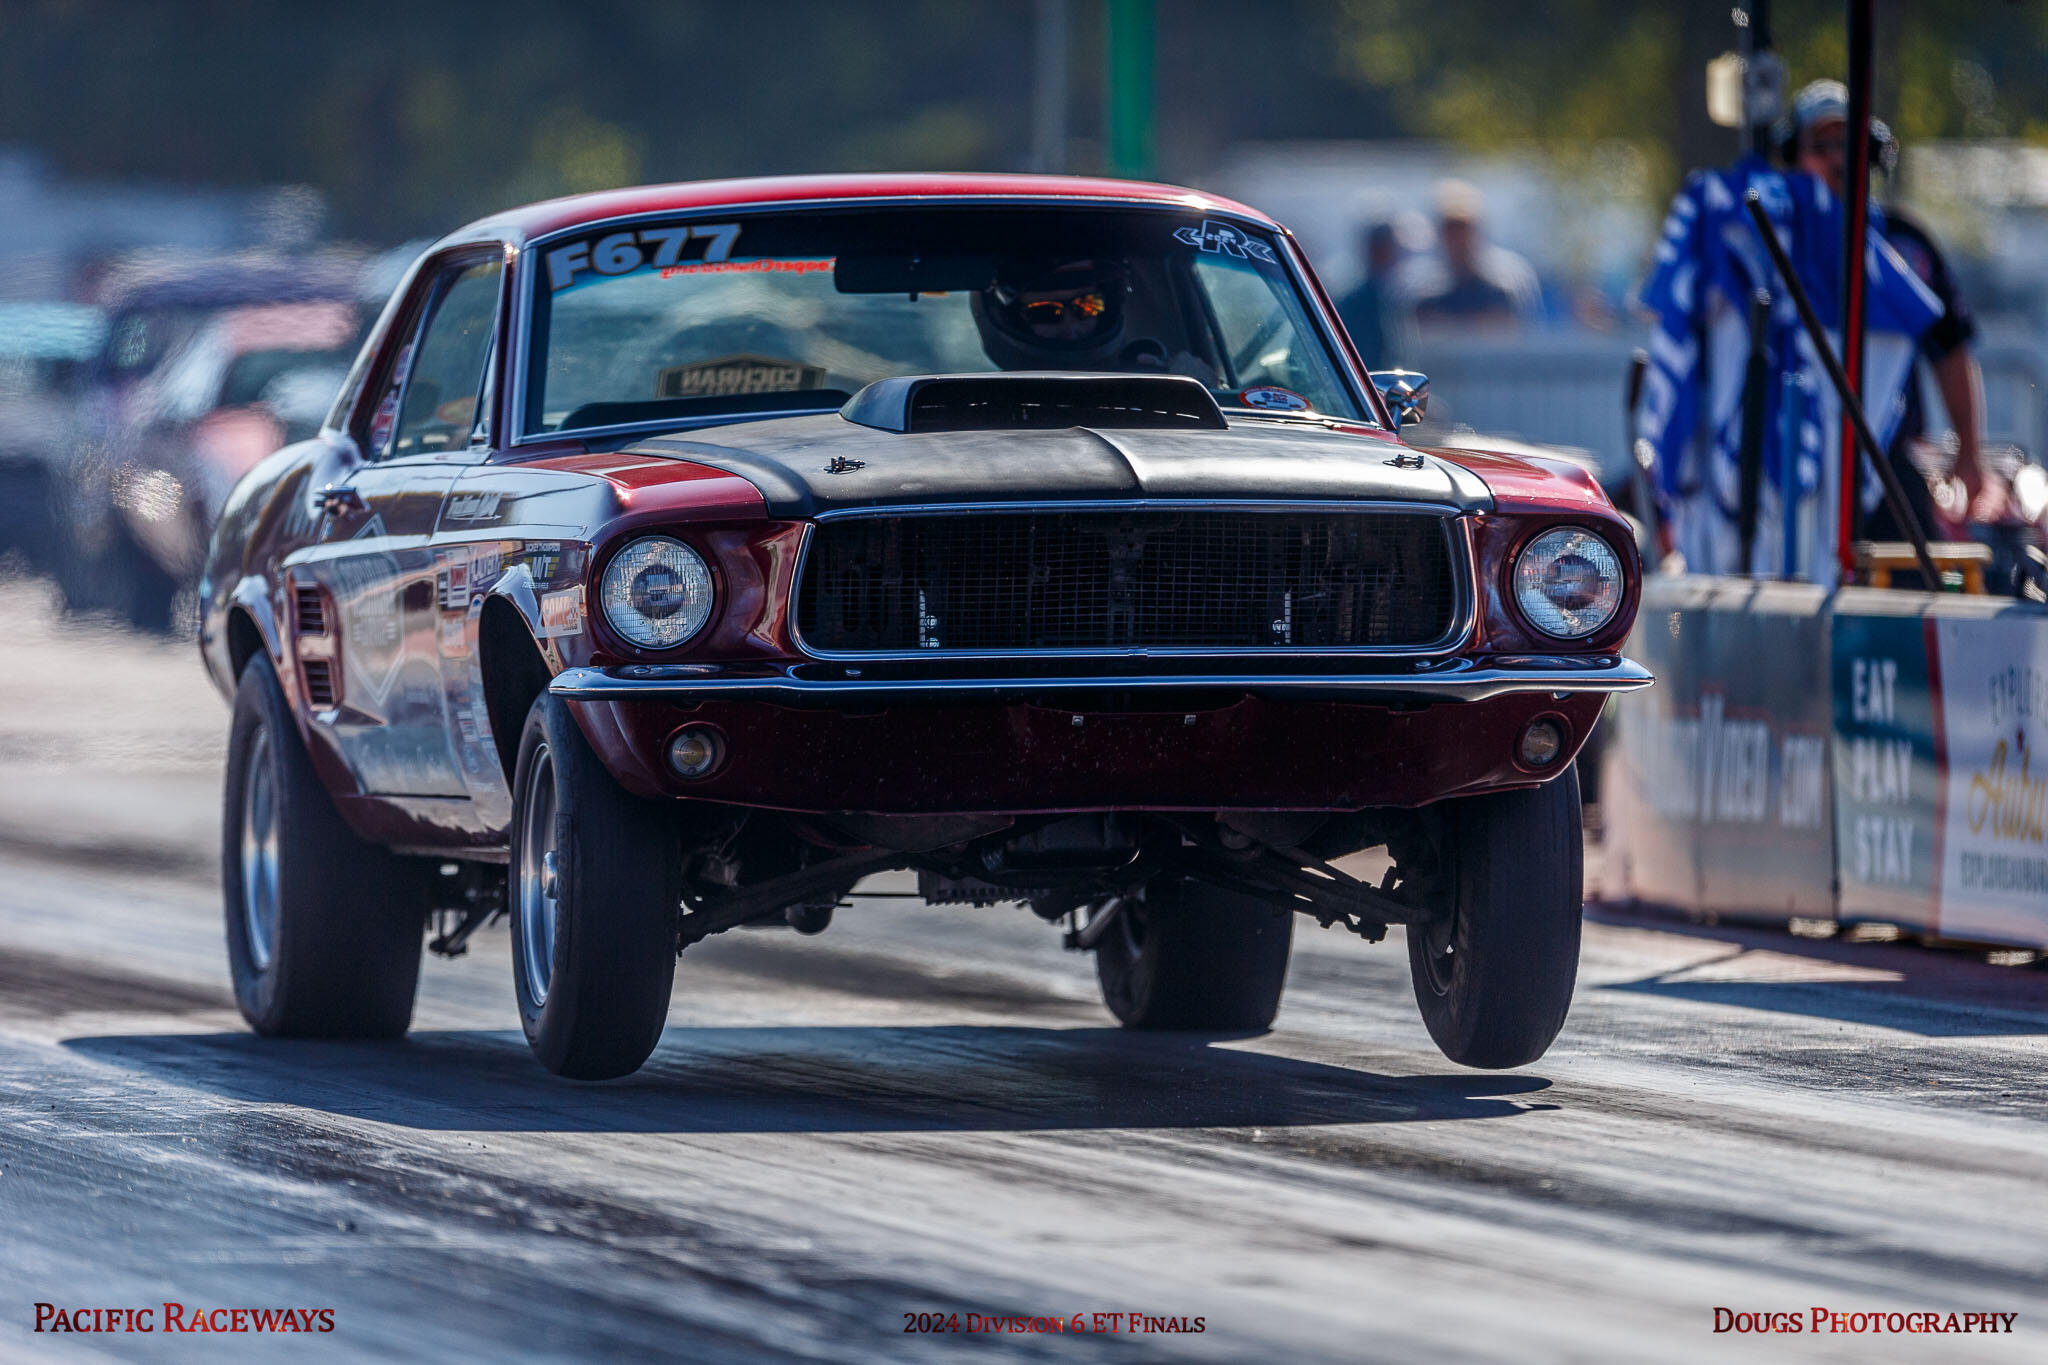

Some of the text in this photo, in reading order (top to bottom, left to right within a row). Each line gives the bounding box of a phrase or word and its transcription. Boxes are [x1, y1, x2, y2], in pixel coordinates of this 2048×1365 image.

[547, 223, 742, 292] F677
[1851, 657, 1898, 724] EAT
[1853, 738, 1912, 804] PLAY
[1968, 738, 2048, 842] Aubu
[1855, 815, 1914, 882] STAY
